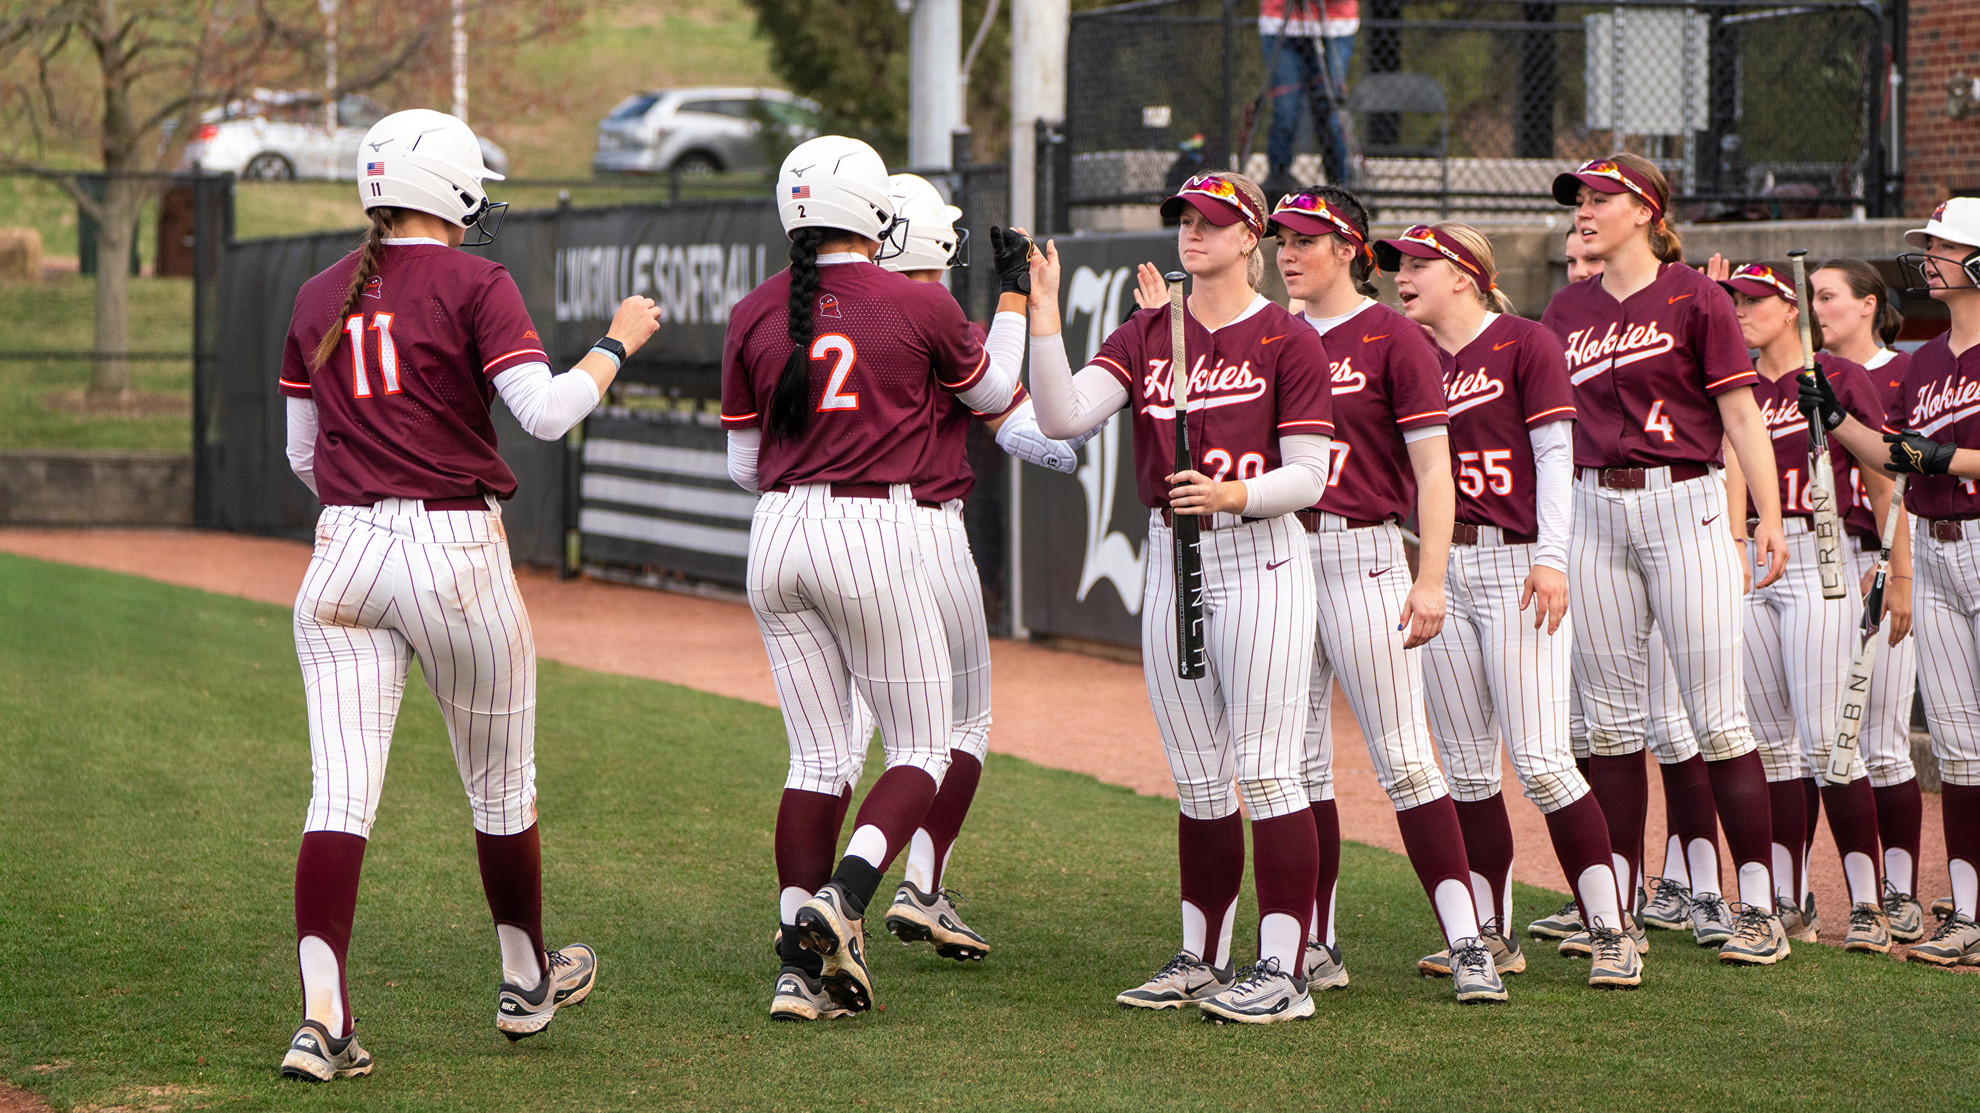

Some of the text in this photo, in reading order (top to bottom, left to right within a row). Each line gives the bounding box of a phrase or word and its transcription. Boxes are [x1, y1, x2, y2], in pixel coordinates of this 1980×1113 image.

[371, 182, 381, 197] 11
[797, 205, 806, 218] 2
[343, 311, 403, 399] 11
[1565, 321, 1675, 371] Hokies
[809, 332, 859, 412] 2
[1143, 354, 1266, 402] Hkies
[1644, 399, 1675, 442] 4
[1909, 374, 1980, 427] Hokie
[1458, 449, 1513, 498] 55
[501, 1001, 517, 1012] NIKE
[780, 984, 797, 993] NIKE
[297, 1037, 316, 1048] NIKE
